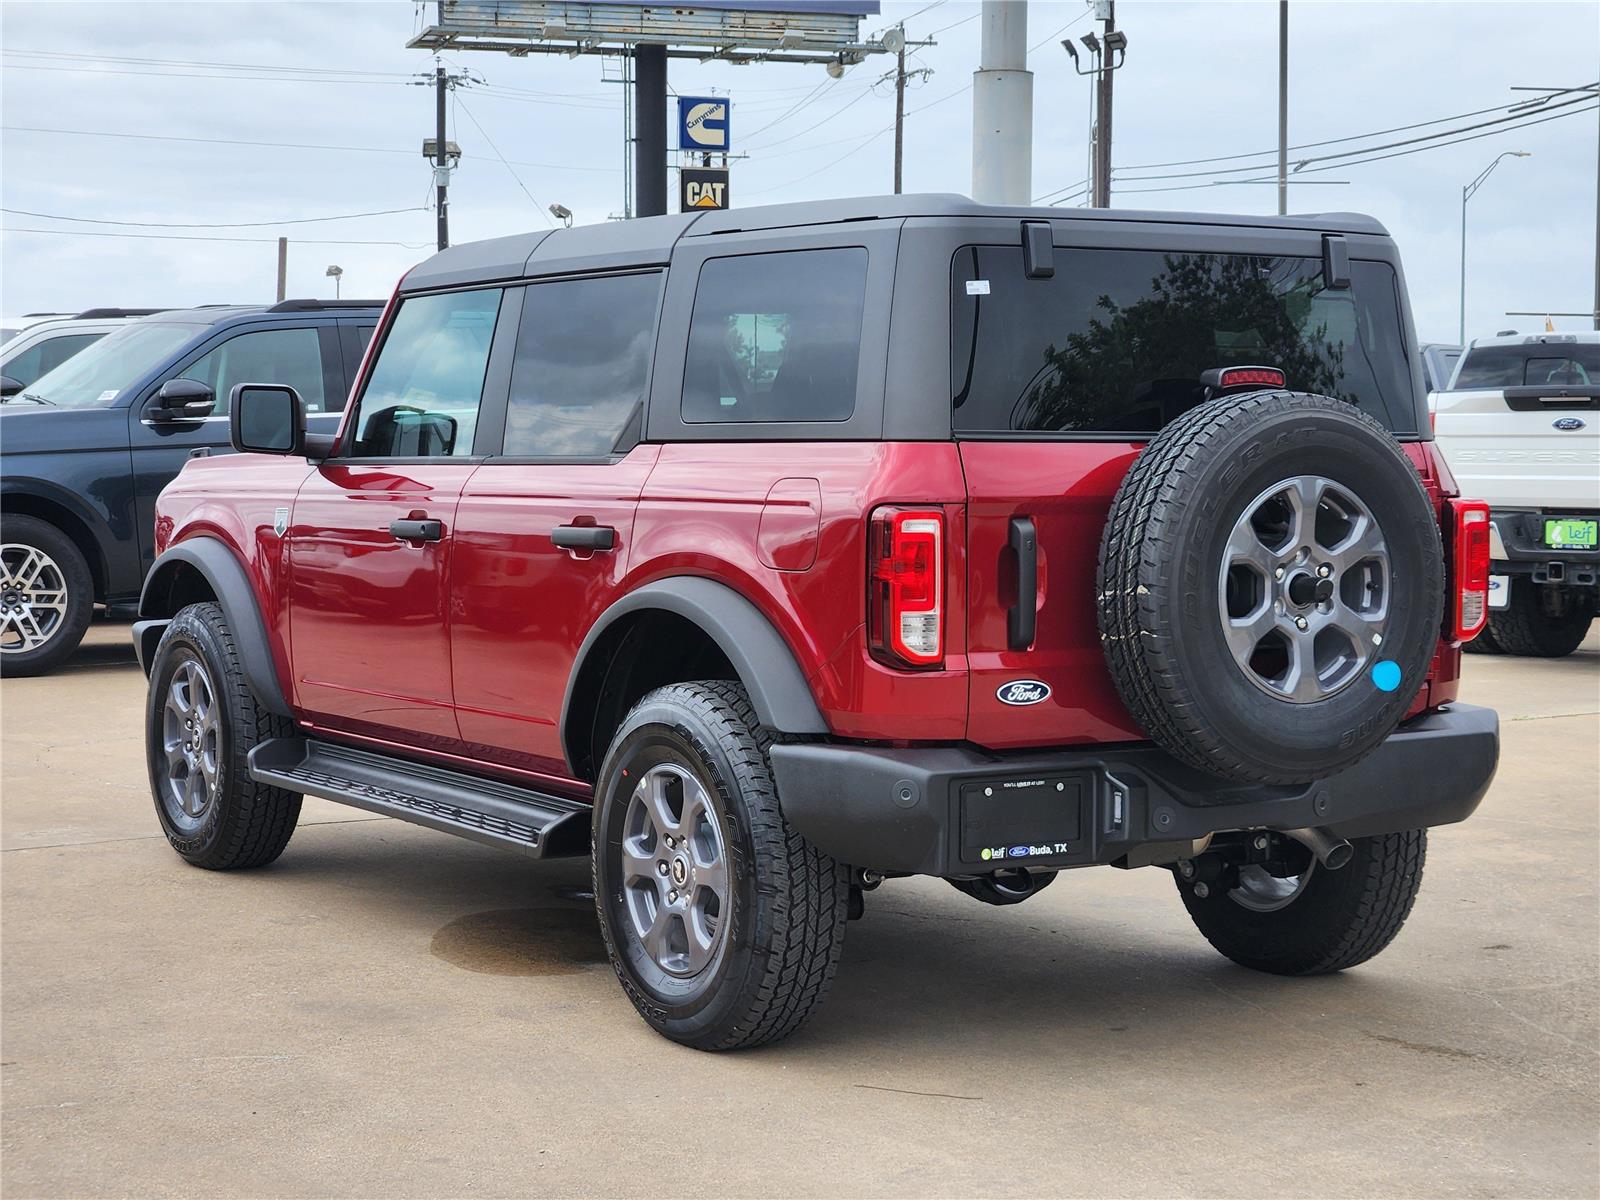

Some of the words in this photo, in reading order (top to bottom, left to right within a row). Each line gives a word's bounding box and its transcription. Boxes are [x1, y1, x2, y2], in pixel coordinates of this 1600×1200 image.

[687, 104, 721, 129] Cummins
[686, 181, 725, 207] CAT
[1007, 684, 1042, 701] Ford
[1029, 845, 1053, 856] Buda,
[1054, 843, 1068, 853] TX
